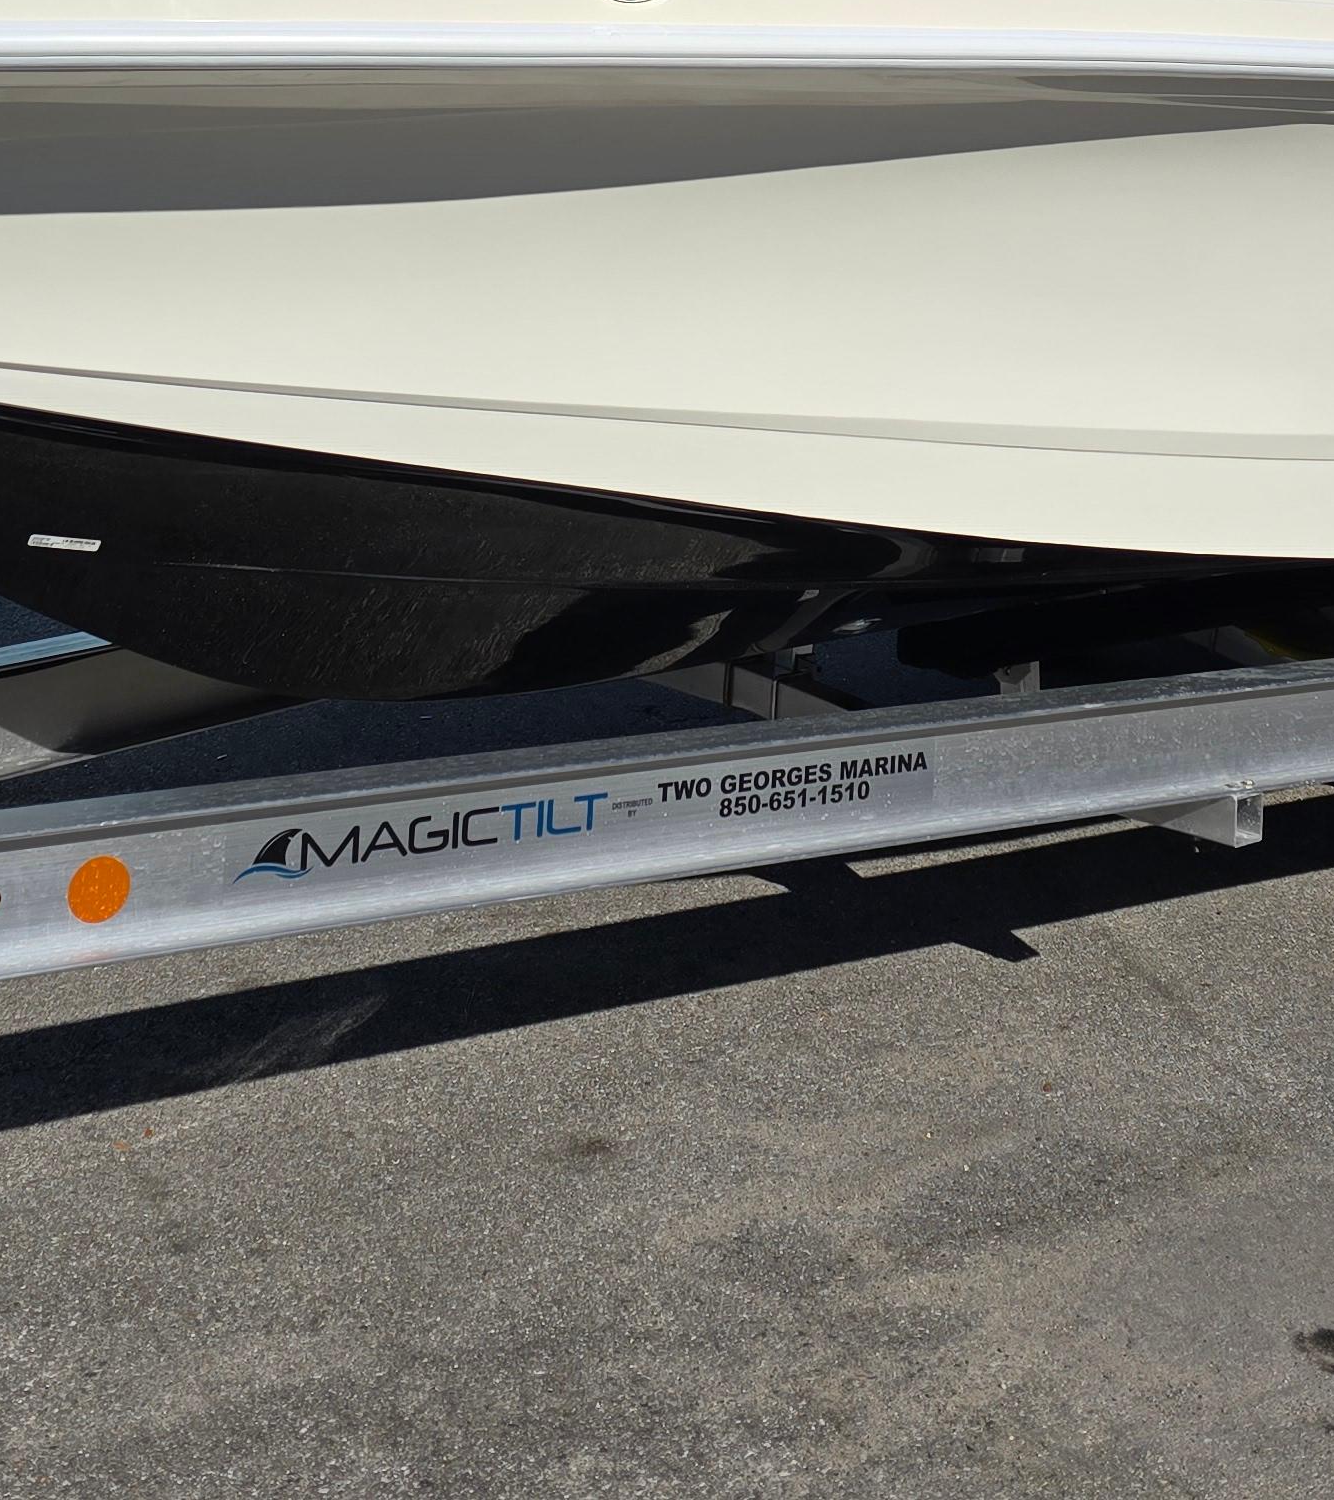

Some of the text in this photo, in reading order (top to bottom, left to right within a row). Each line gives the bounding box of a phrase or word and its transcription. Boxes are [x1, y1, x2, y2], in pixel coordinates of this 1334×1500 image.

[658, 751, 928, 803] TWO GEORGES MARINA
[719, 781, 870, 818] 850-651-1510
[301, 792, 609, 870] MAGICTILT
